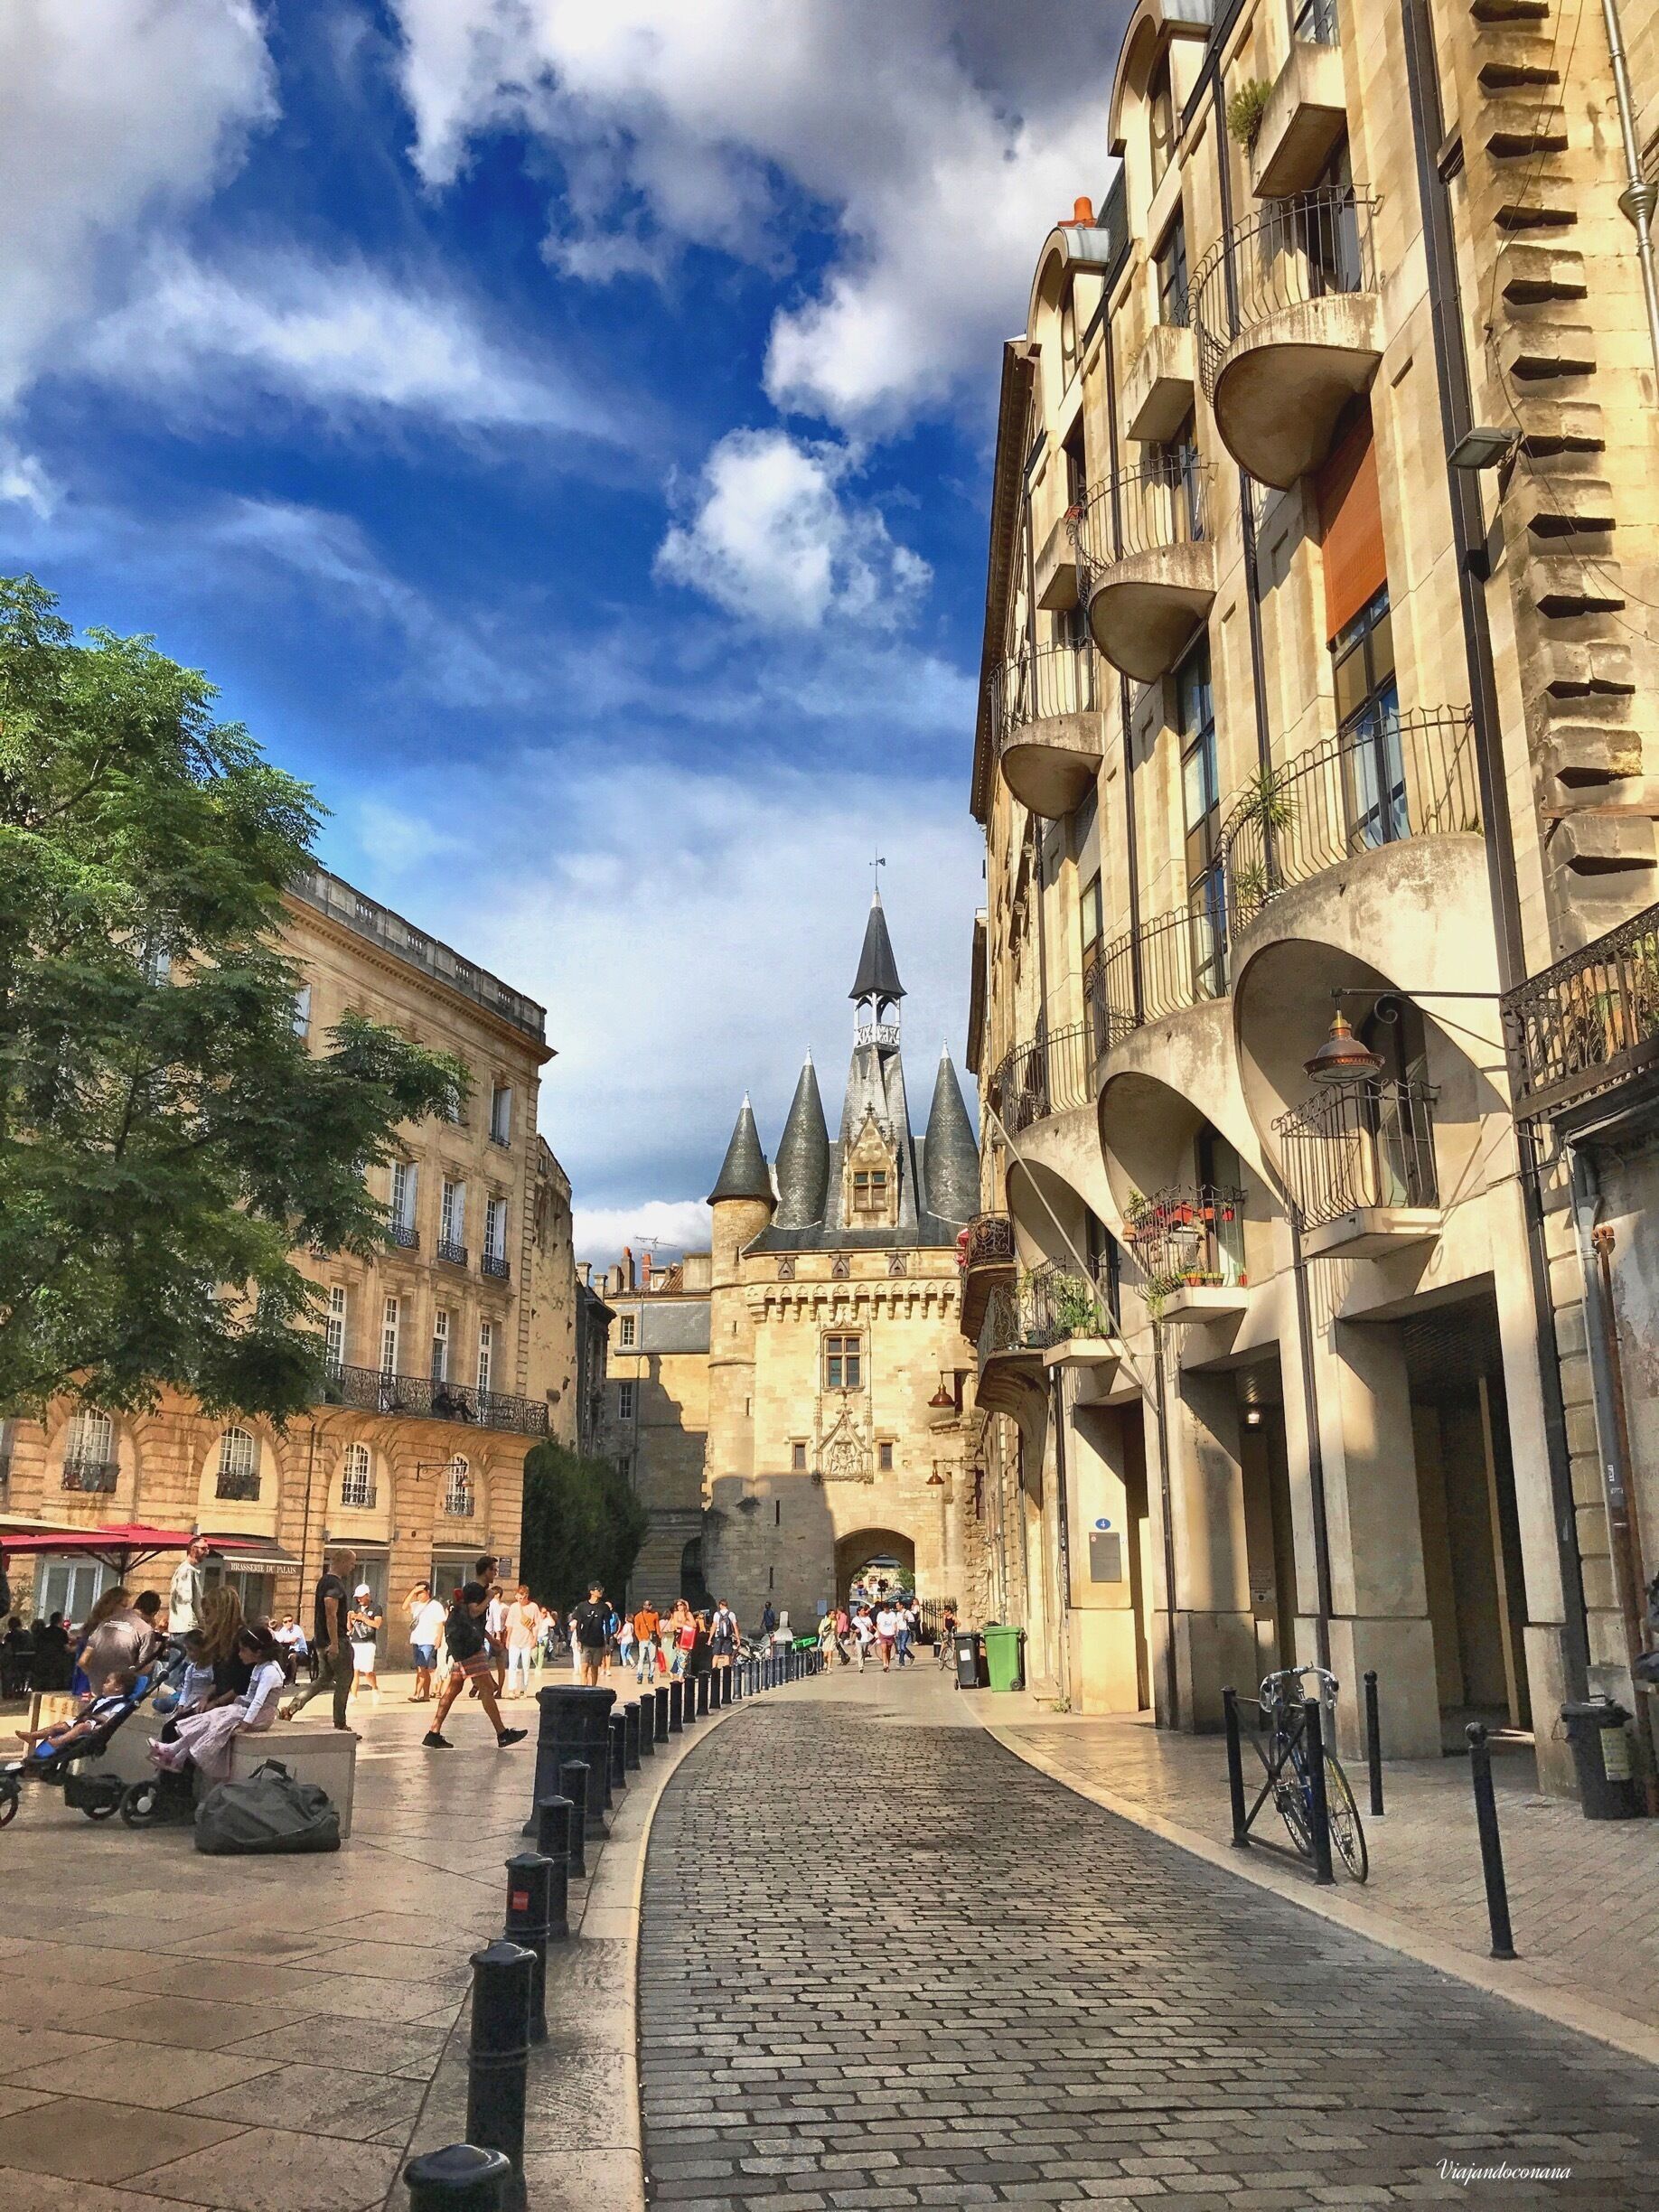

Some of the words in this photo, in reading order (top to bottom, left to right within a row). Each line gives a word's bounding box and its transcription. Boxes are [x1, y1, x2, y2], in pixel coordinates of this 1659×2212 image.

[230, 1562, 265, 1572] BRASSERIE
[266, 1565, 275, 1573] DU
[276, 1566, 296, 1574] PALAIS
